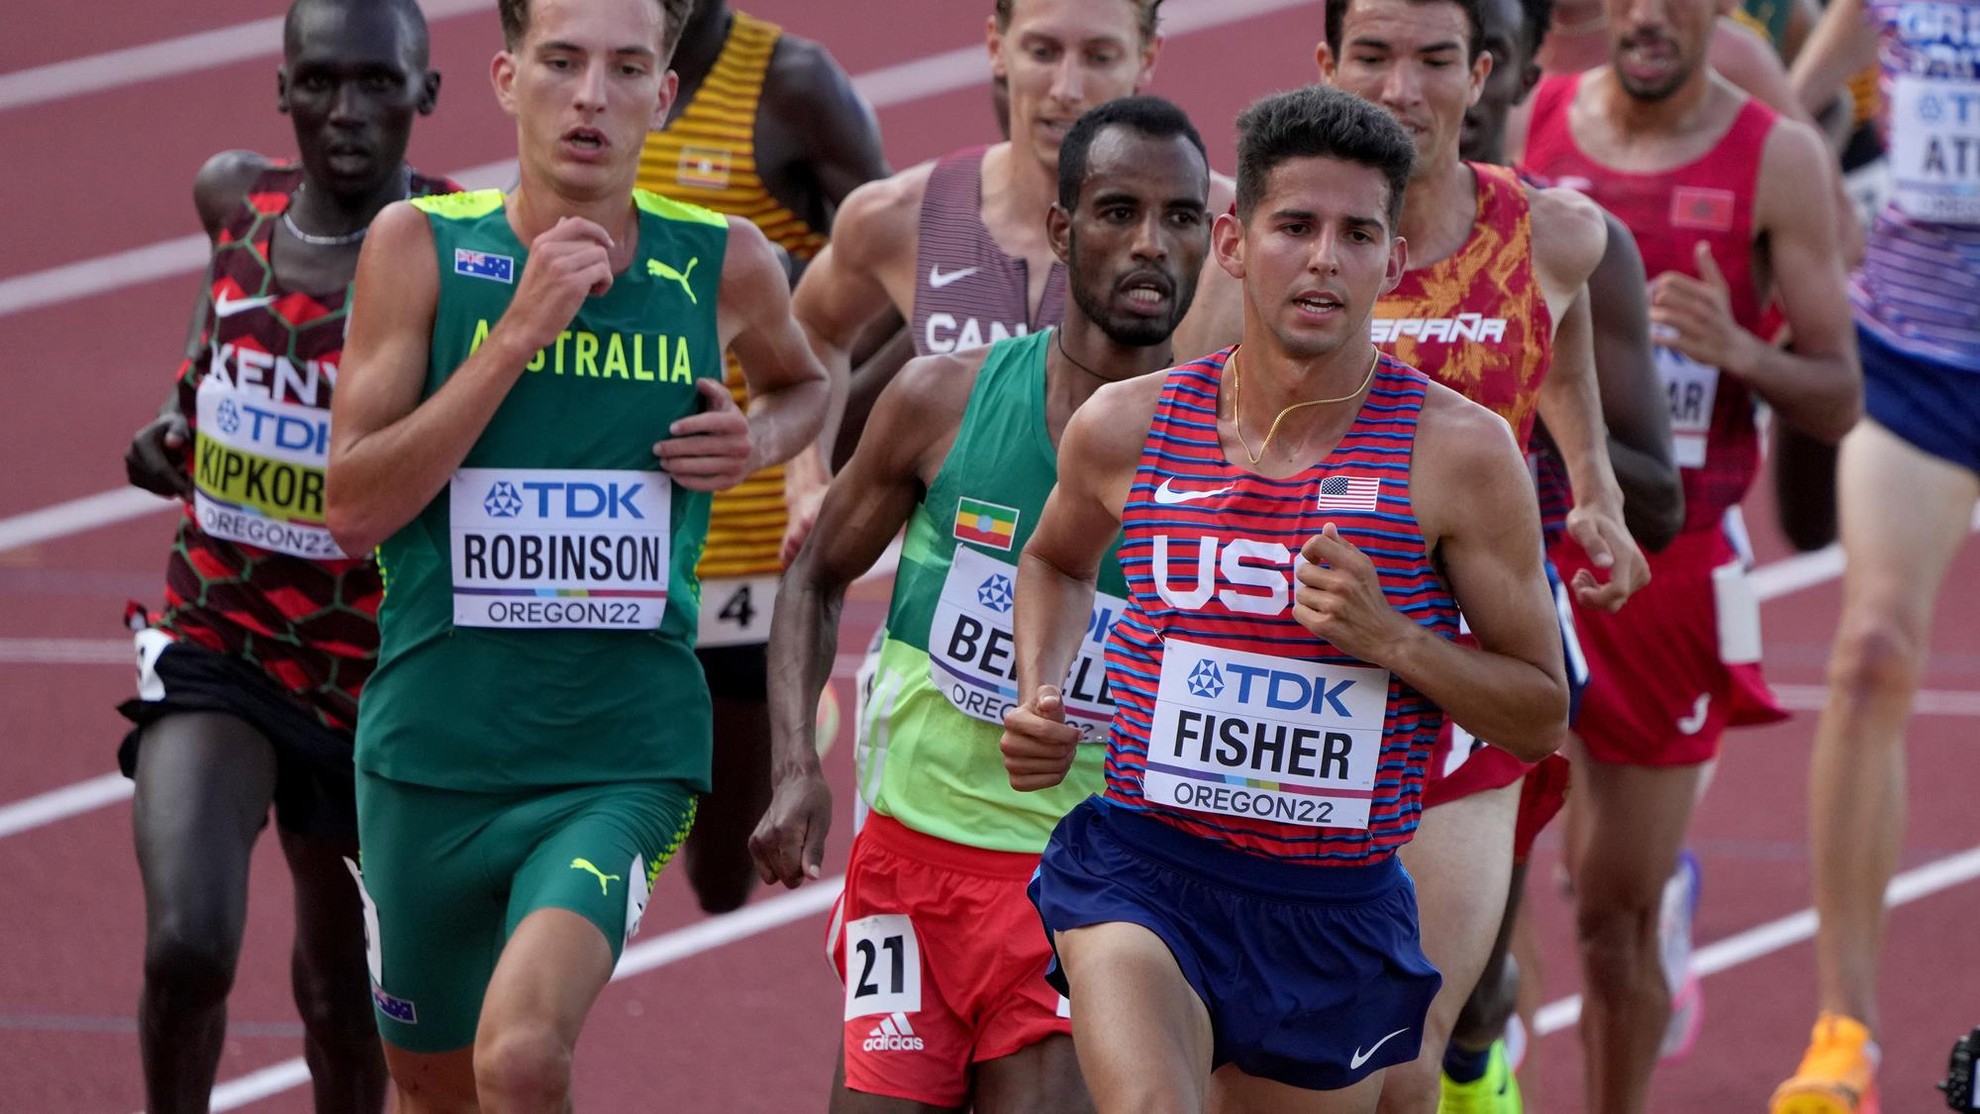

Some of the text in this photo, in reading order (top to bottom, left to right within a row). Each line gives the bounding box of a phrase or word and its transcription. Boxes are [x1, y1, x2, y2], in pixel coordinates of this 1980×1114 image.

[1924, 138, 1980, 176] AT
[469, 319, 693, 385] ATRALIA
[926, 311, 1056, 354] CAN
[523, 482, 645, 519] TDK
[464, 533, 660, 582] ROBINSON
[1152, 534, 1311, 616] US
[488, 601, 641, 624] OREGON22
[718, 585, 757, 628] 4
[1225, 663, 1357, 718] TDK
[1173, 709, 1353, 781] FISHER
[1174, 782, 1334, 824] OREGON22
[854, 935, 904, 999] 21
[863, 1034, 924, 1052] adidas
